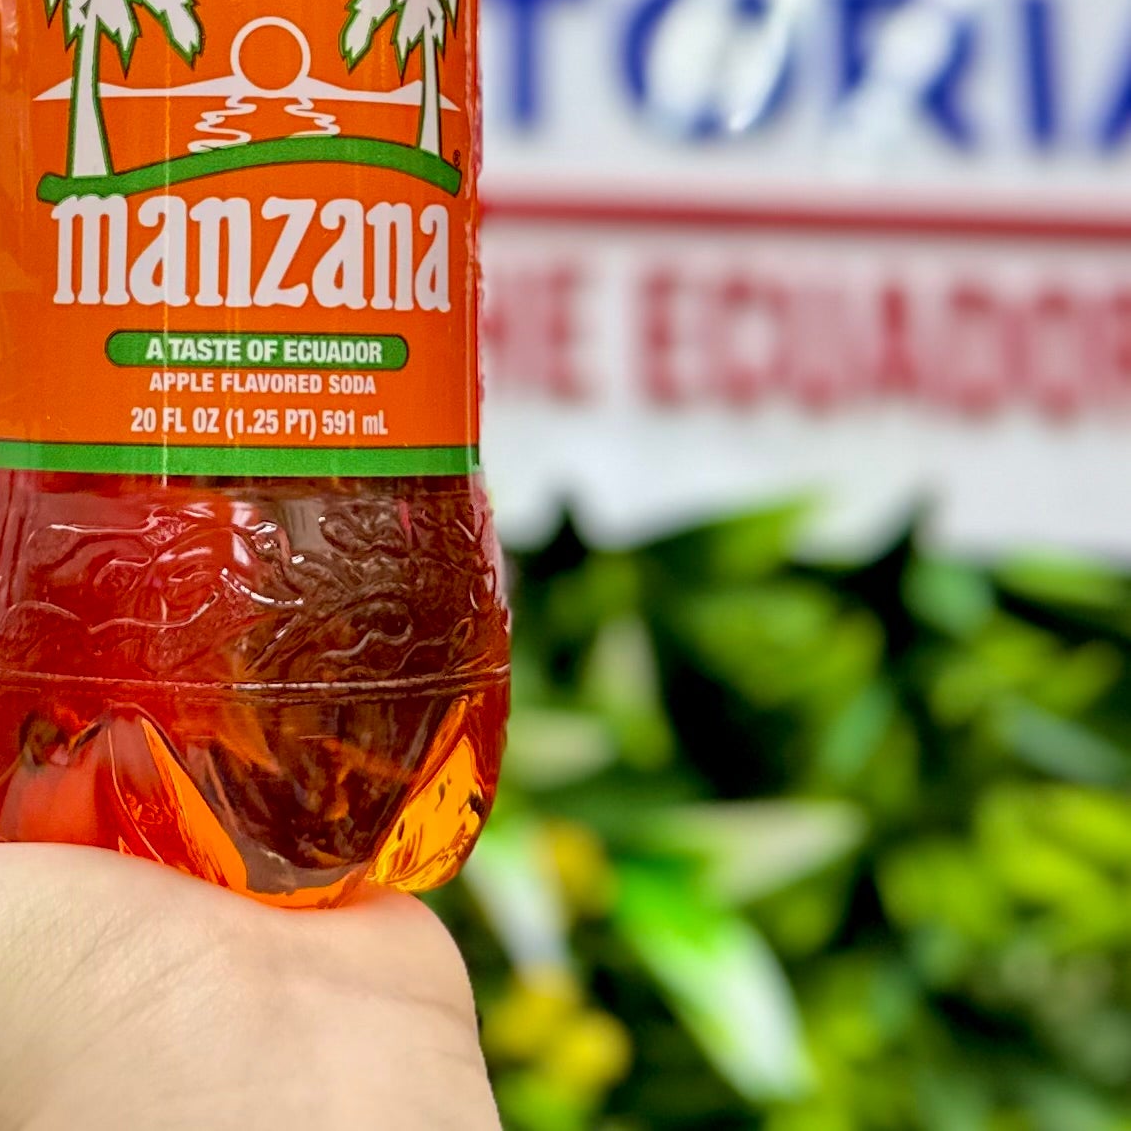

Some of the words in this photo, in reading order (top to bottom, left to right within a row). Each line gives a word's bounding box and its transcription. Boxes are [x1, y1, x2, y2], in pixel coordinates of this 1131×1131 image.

[51, 194, 451, 312] manzana
[146, 340, 165, 360] A
[167, 339, 241, 361] TASTE
[247, 340, 277, 362] OF
[283, 340, 382, 363] ECUADOR
[149, 372, 214, 392] APPLE
[221, 373, 322, 394] FLAVORED
[328, 375, 376, 395] SODA
[130, 408, 155, 433] 20
[163, 408, 187, 433] FL
[192, 408, 219, 434] OZ
[225, 408, 279, 438] (1.25
[285, 409, 316, 440] PT)
[322, 410, 355, 435] 591
[362, 411, 388, 436] mL
